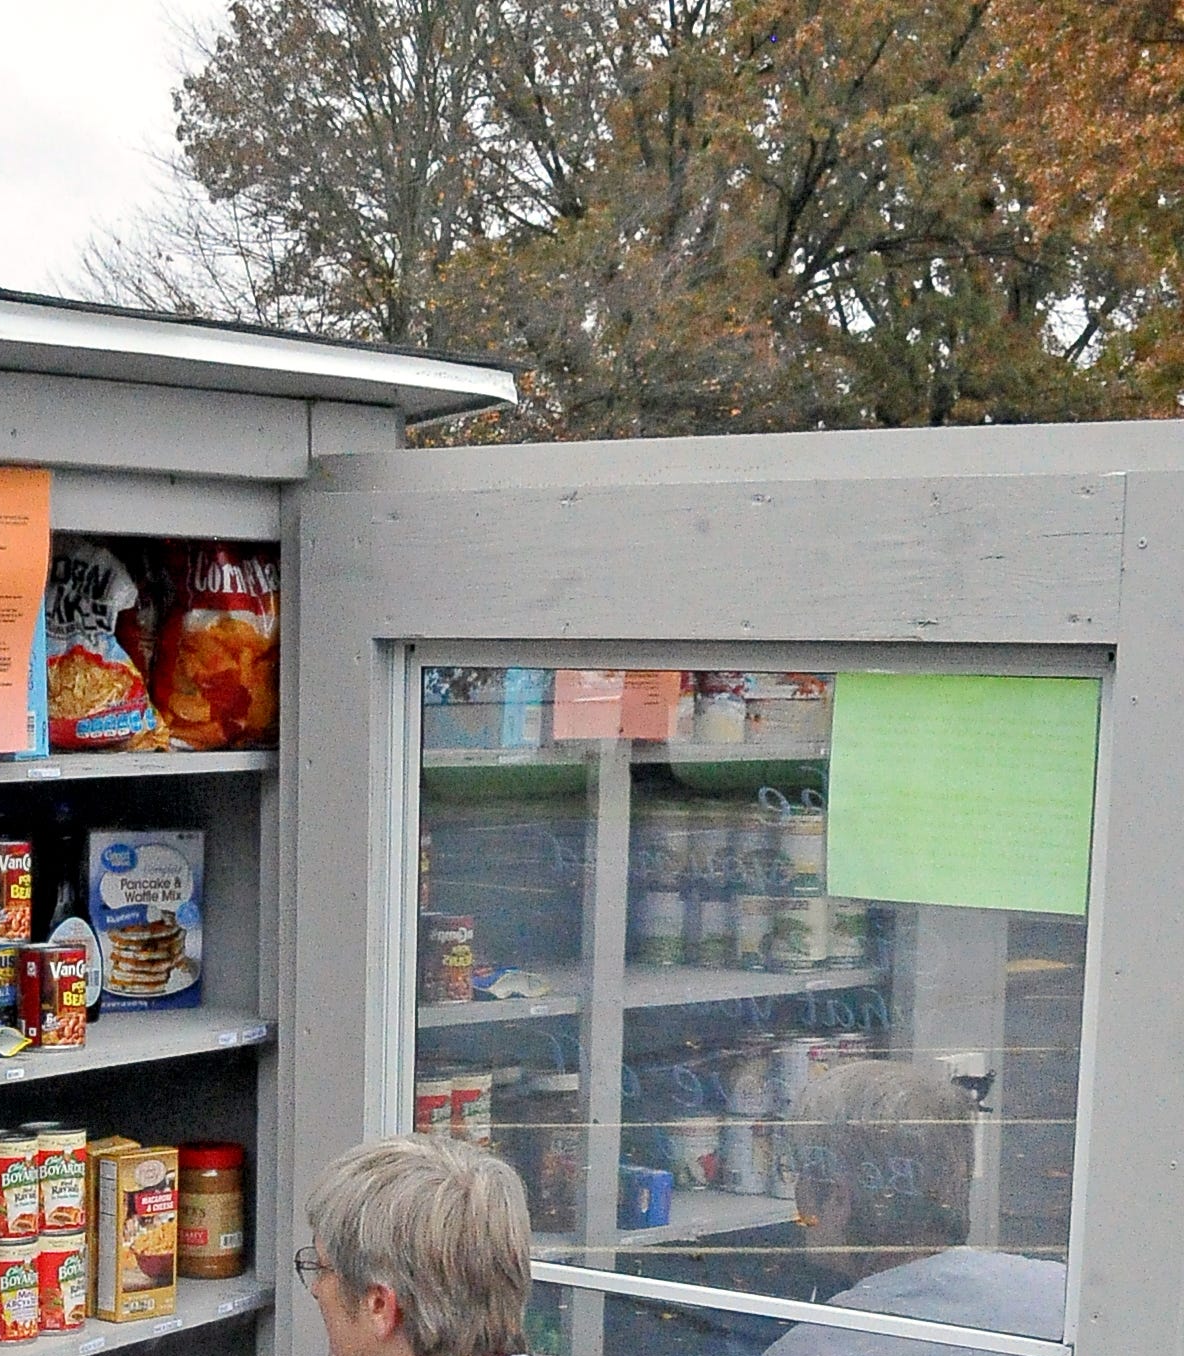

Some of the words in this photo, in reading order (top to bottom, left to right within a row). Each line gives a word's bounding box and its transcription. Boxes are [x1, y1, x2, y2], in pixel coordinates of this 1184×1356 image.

[120, 877, 172, 890] Pancake
[125, 891, 159, 903] Waffle
[161, 891, 182, 902] Mix
